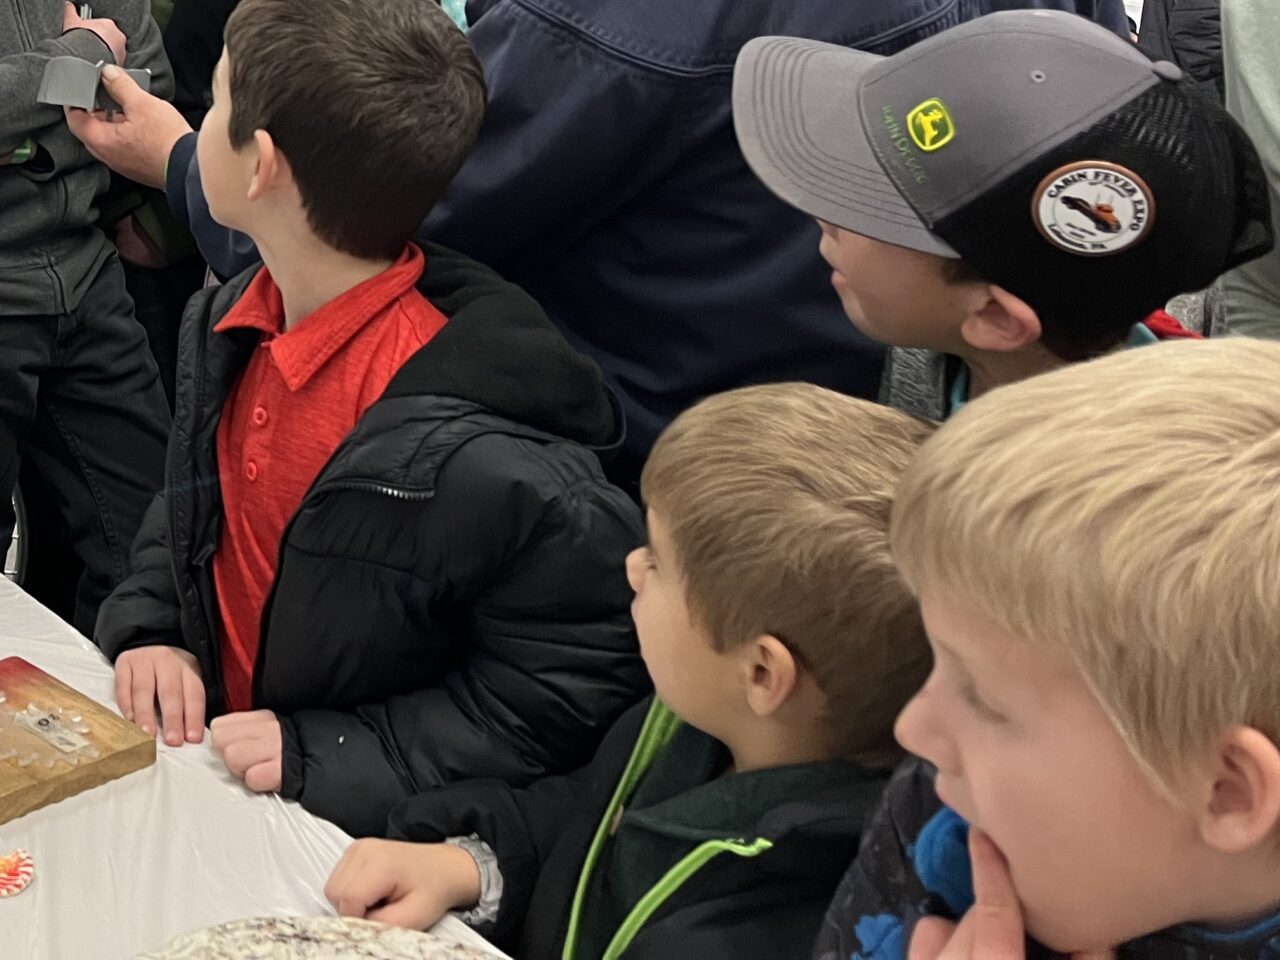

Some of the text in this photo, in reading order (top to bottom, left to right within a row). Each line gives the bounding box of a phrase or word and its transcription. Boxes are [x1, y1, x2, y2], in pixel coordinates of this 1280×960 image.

[1047, 171, 1088, 199] CABIN
[1093, 171, 1138, 196] FEVER
[1129, 199, 1145, 231] EXPO
